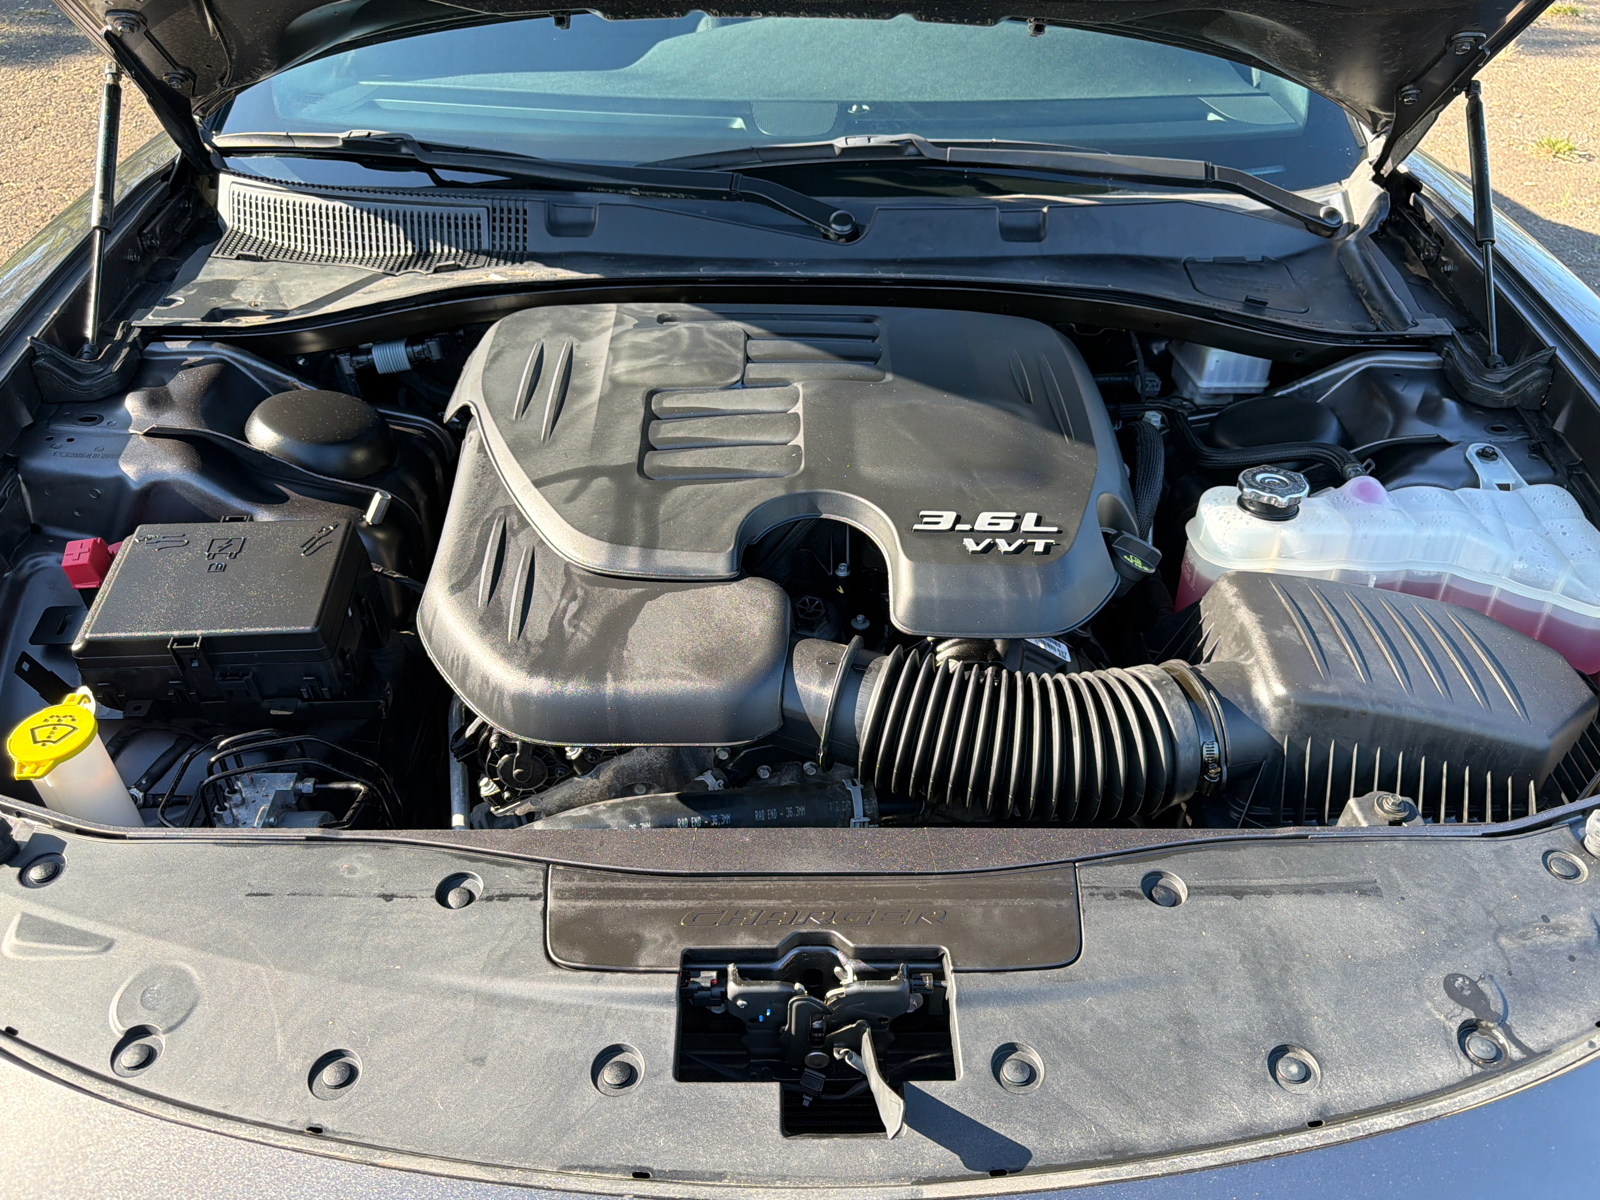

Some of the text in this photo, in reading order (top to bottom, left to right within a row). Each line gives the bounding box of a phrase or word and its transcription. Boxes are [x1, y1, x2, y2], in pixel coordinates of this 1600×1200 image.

[911, 510, 1059, 532] 3.6L
[962, 538, 1056, 555] VVT
[754, 809, 765, 821] RAD
[767, 808, 778, 820] END
[680, 909, 948, 926] CHARGER
